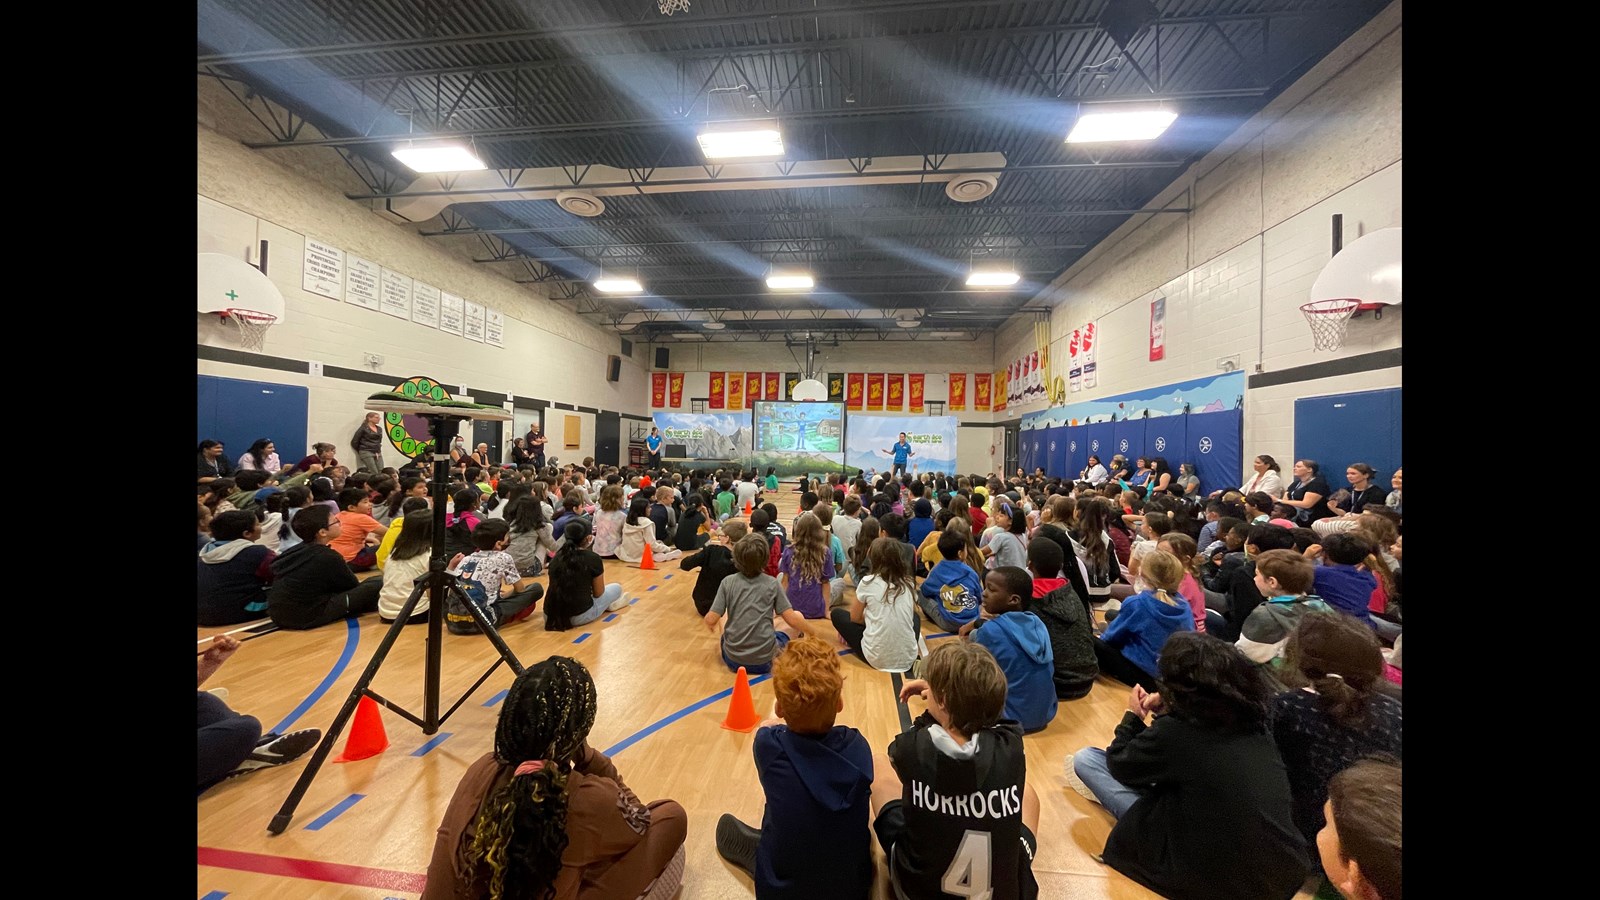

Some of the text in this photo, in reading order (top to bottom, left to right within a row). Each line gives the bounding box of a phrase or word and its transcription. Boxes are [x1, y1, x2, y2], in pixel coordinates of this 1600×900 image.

[408, 386, 413, 394] 11
[422, 383, 428, 392] 12
[942, 591, 954, 600] W
[912, 780, 1020, 819] HORROCKS
[941, 829, 994, 900] 4
